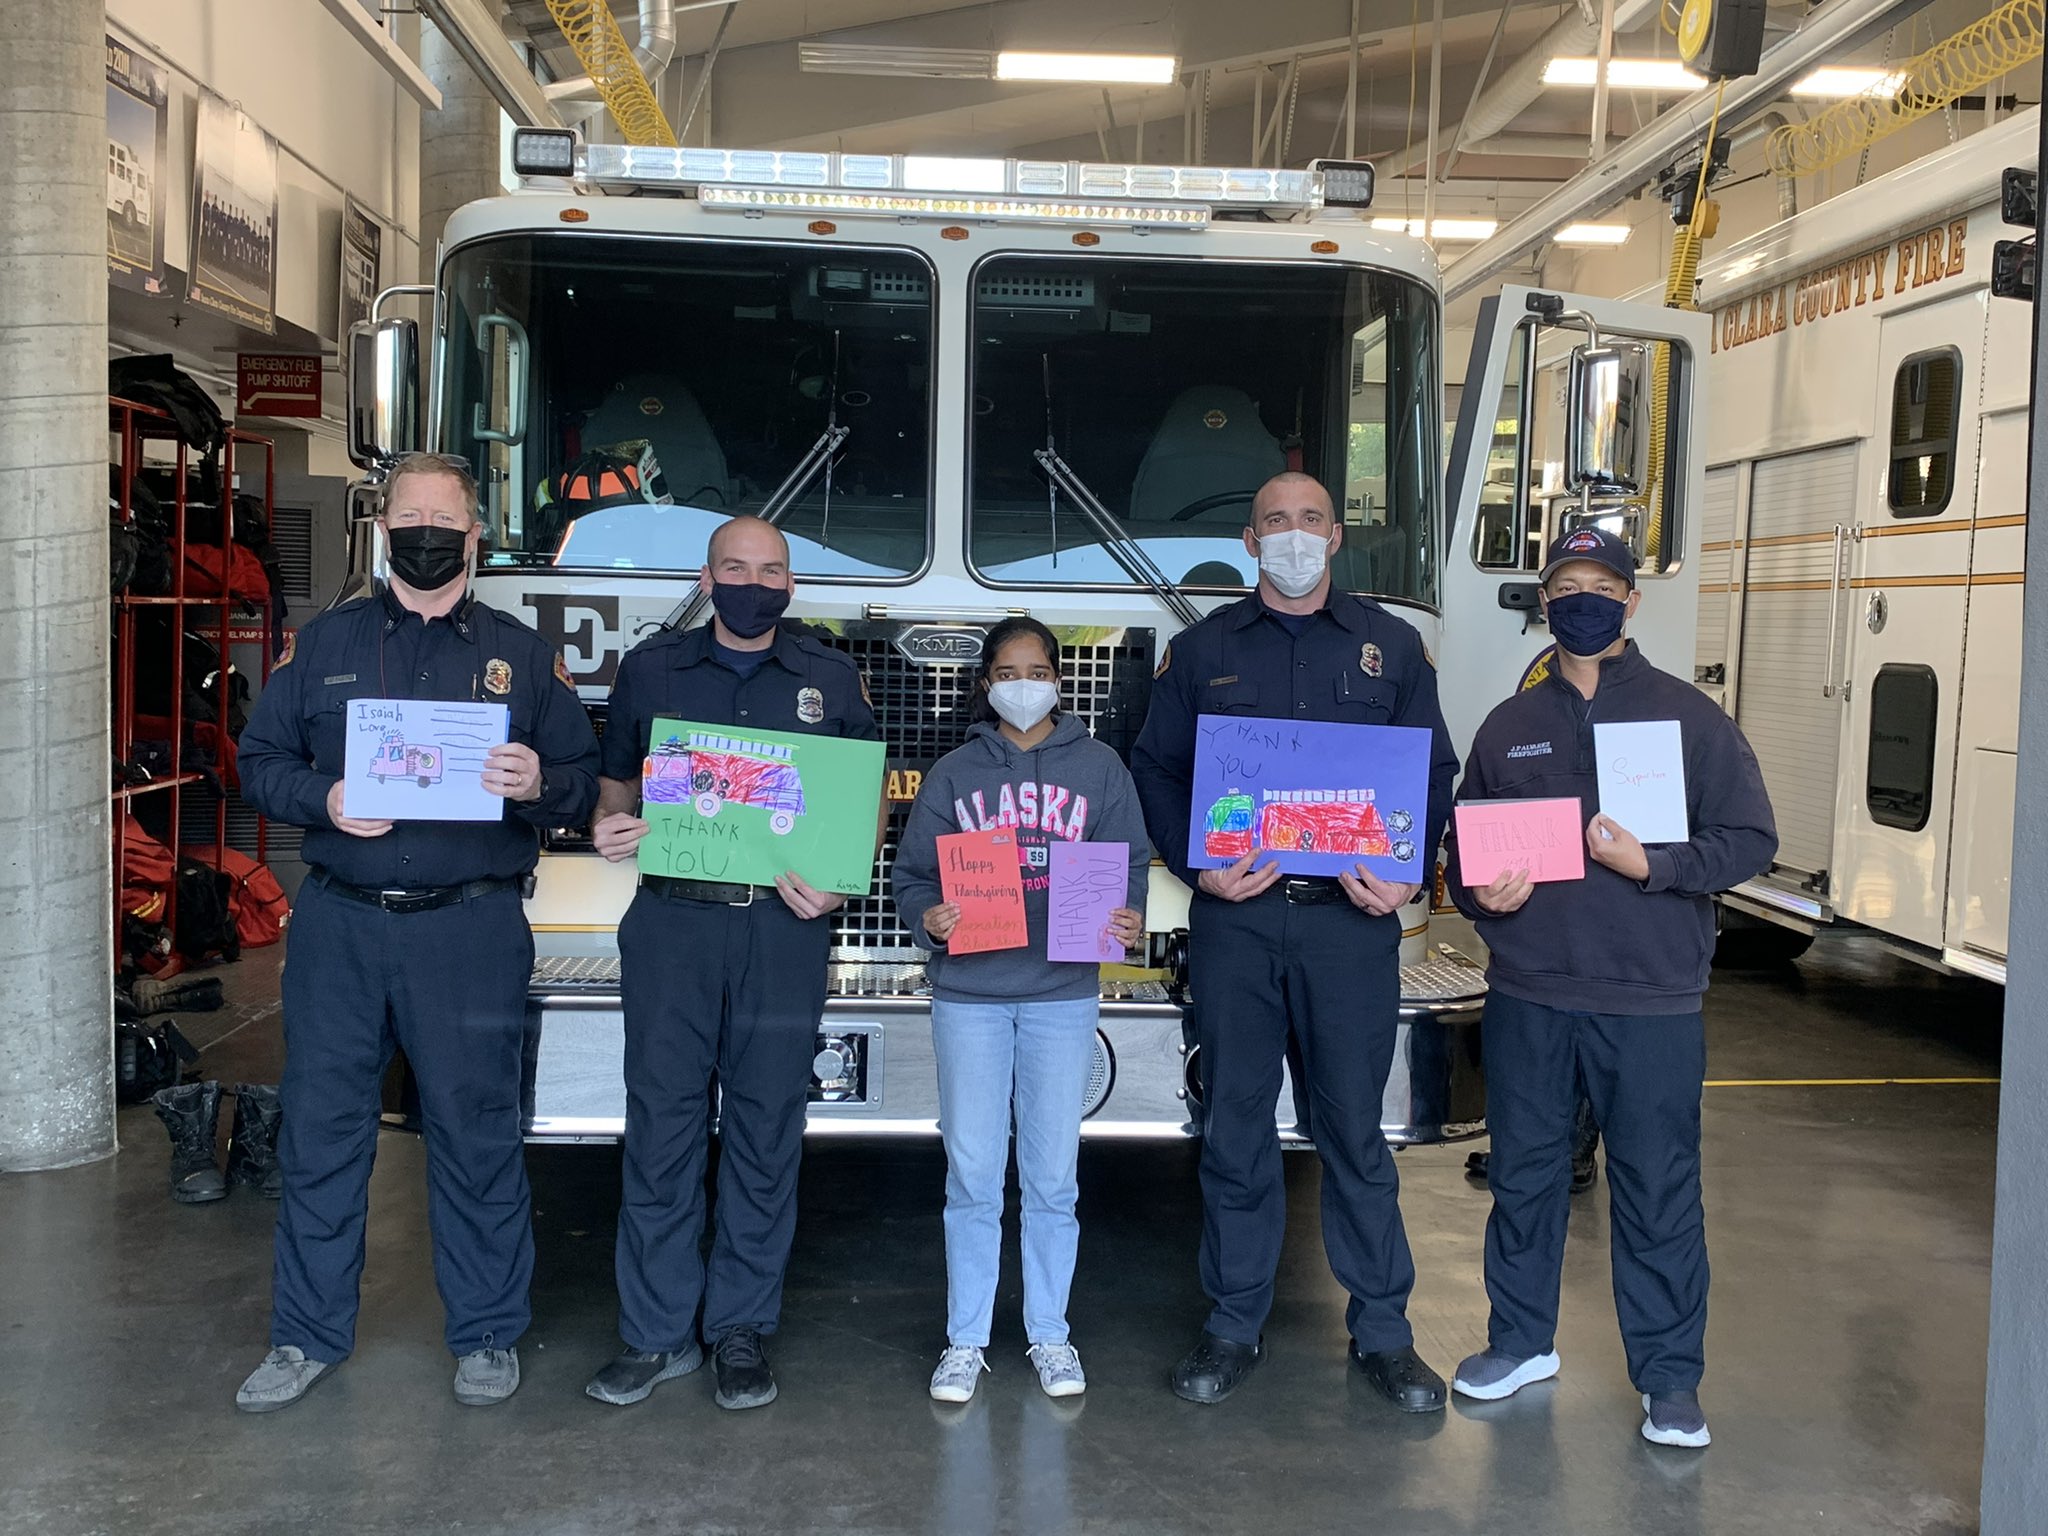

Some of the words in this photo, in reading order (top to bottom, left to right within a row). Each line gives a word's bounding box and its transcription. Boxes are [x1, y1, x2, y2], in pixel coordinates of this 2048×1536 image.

[1722, 285, 1787, 350] CLARA
[1793, 245, 1891, 326] COUNTY
[1894, 216, 1968, 294] FIRE
[241, 356, 295, 371] EMERGENCY
[295, 359, 317, 372] FUEL
[247, 373, 271, 387] PUMP
[272, 374, 312, 388] SHUTOFF
[522, 593, 619, 686] E
[912, 638, 972, 651] KME
[357, 702, 403, 722] Isaiah
[1507, 747, 1553, 758] FIREFIGHTER
[1215, 753, 1262, 781] YOU
[954, 781, 1089, 842] ALASKA
[661, 814, 740, 842] THANK
[1469, 818, 1562, 853] THANK
[661, 842, 730, 878] YOU
[946, 846, 996, 874] Happy
[1030, 851, 1044, 862] 59
[948, 883, 1019, 905] Thanksgiving
[1056, 872, 1089, 950] THANK
